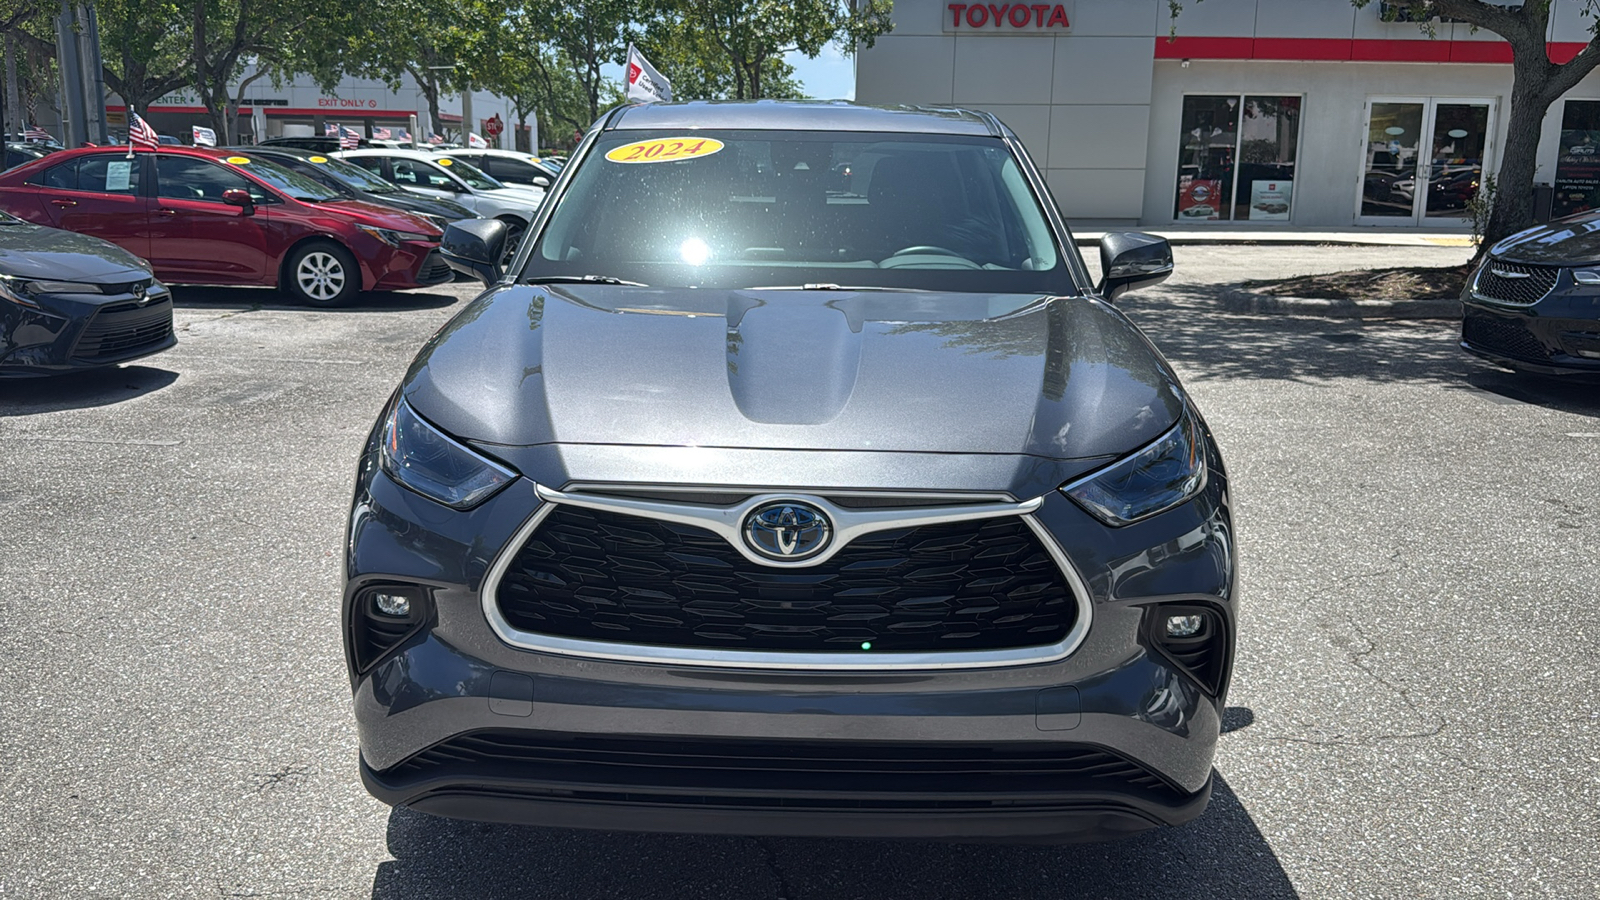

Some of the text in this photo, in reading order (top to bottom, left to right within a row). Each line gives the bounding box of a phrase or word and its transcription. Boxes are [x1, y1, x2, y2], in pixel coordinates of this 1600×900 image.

[948, 4, 1070, 28] TOYOTA
[638, 80, 653, 93] Used
[642, 75, 664, 93] Certified
[157, 96, 187, 104] ENTER
[318, 98, 365, 107] EXIT ONLY
[623, 140, 706, 160] 2024
